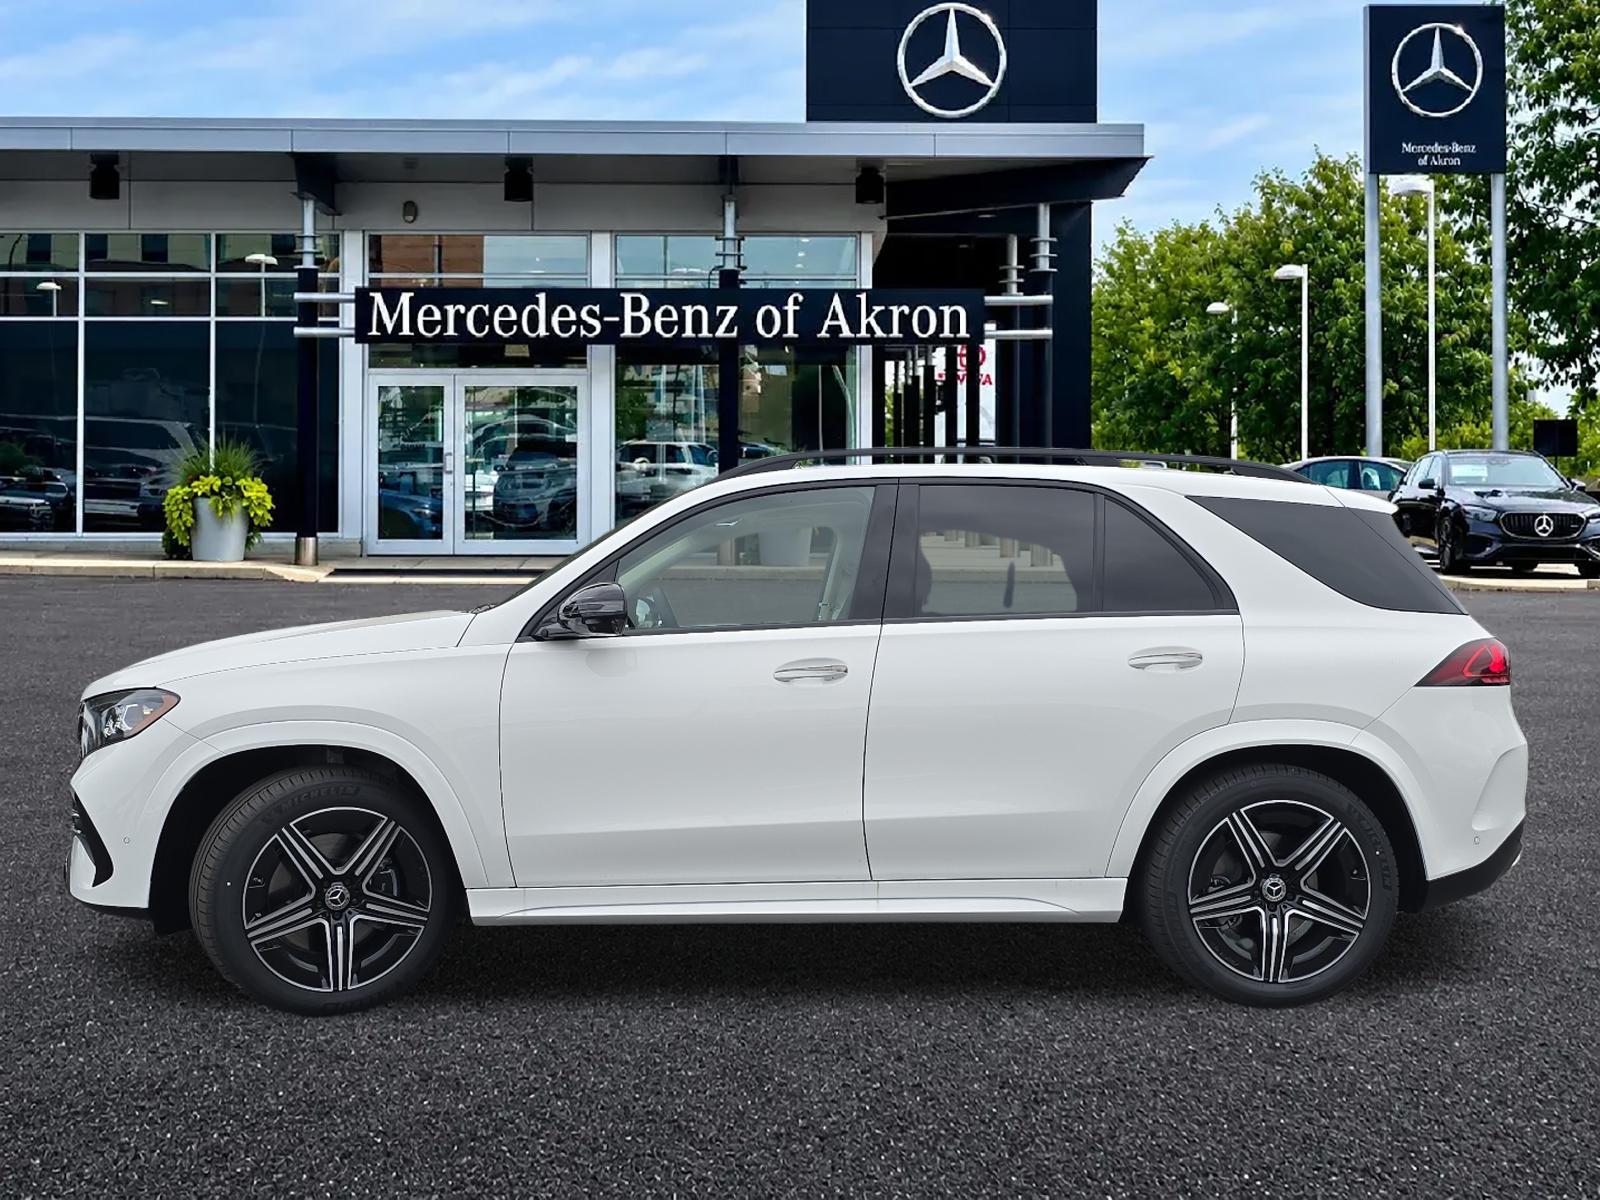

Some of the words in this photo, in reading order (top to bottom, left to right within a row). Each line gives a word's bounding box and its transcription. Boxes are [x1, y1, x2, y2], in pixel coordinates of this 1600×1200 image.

[1401, 141, 1477, 154] Mercedes-Benz
[1417, 154, 1428, 166] of
[1430, 155, 1461, 166] Akron
[367, 291, 738, 339] Mercedes-Benz
[755, 292, 804, 339] of
[816, 291, 971, 339] Akron
